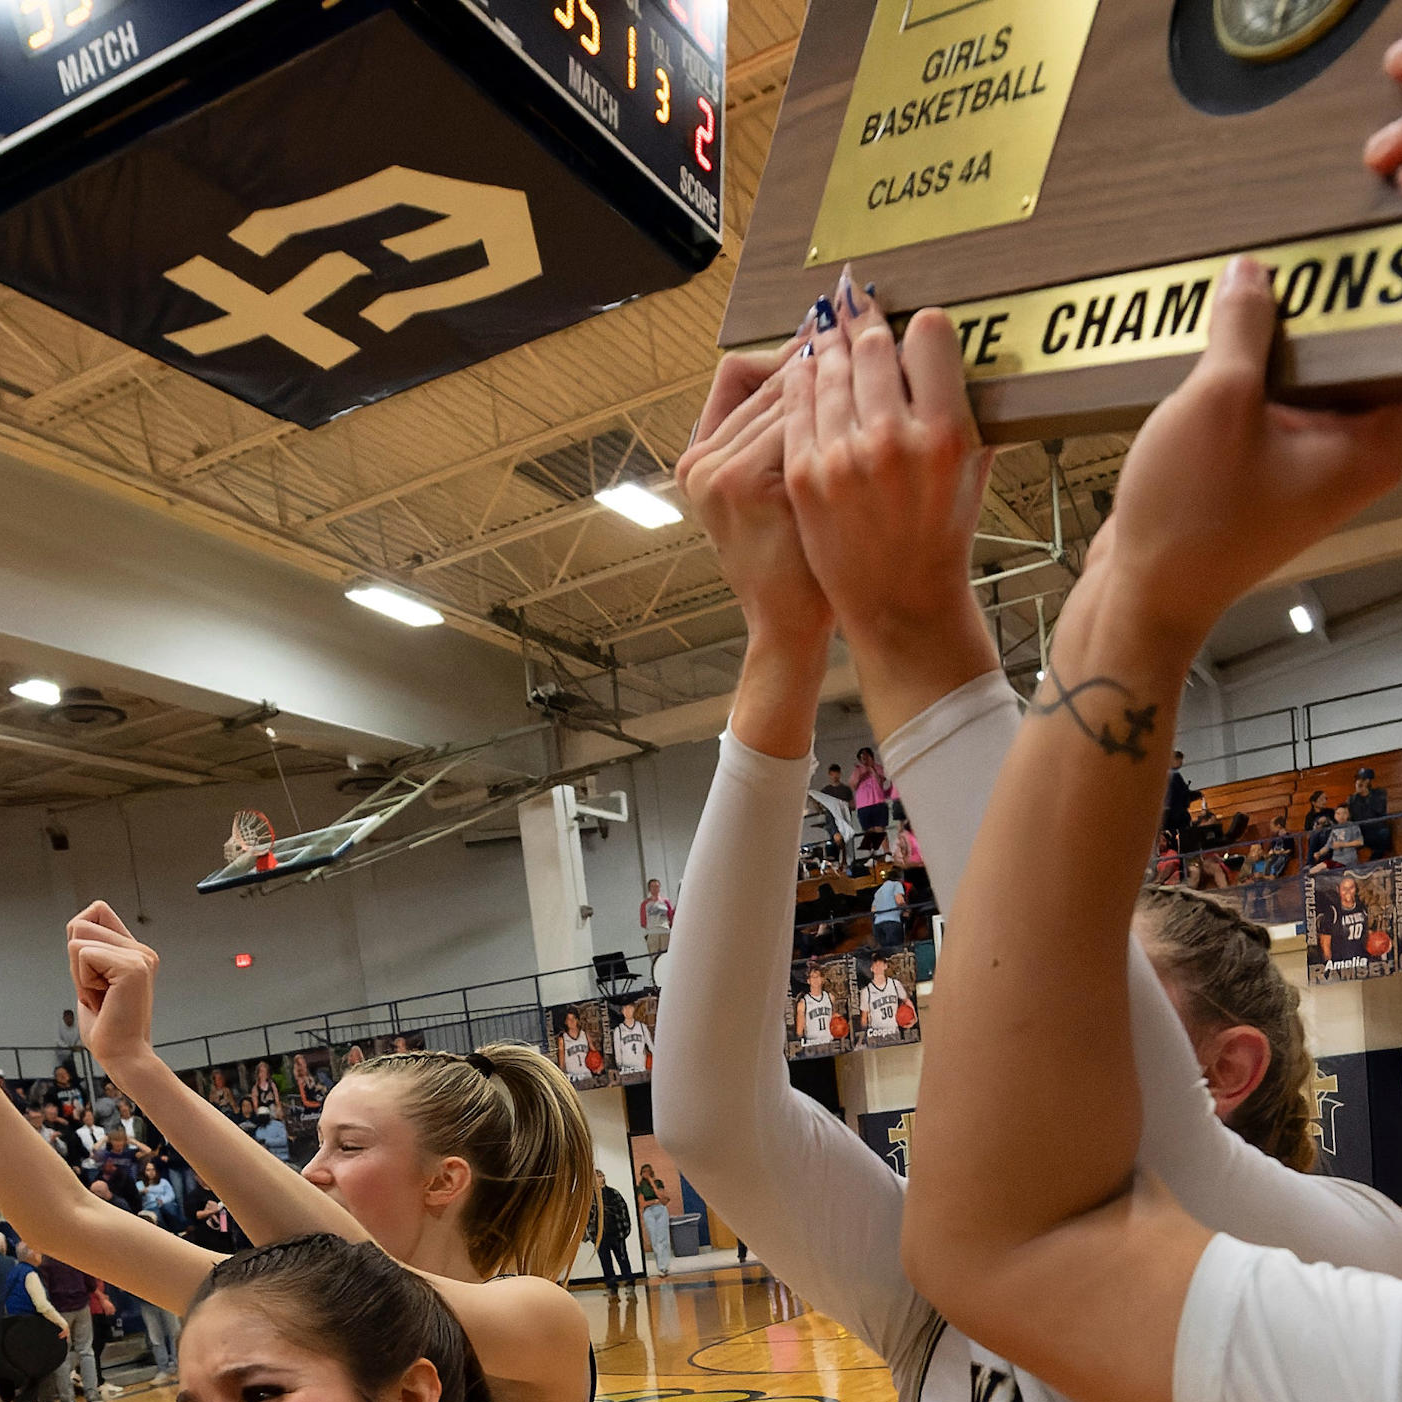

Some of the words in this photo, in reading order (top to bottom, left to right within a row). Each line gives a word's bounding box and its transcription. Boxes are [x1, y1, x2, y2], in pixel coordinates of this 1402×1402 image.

[56, 20, 139, 96] MATCH
[627, 25, 637, 89] 1
[922, 24, 1013, 84] GIRLS
[568, 54, 619, 131] MATCH
[655, 67, 670, 124] 3
[860, 60, 1047, 146] BASKETBALL
[694, 96, 715, 171] 2
[679, 165, 718, 222] SCORE
[867, 160, 955, 210] CLASS
[958, 149, 993, 186] 4A
[1347, 923, 1363, 940] 10
[1324, 956, 1368, 971] Amelia
[818, 1017, 826, 1031] 11
[880, 1006, 894, 1020] 30
